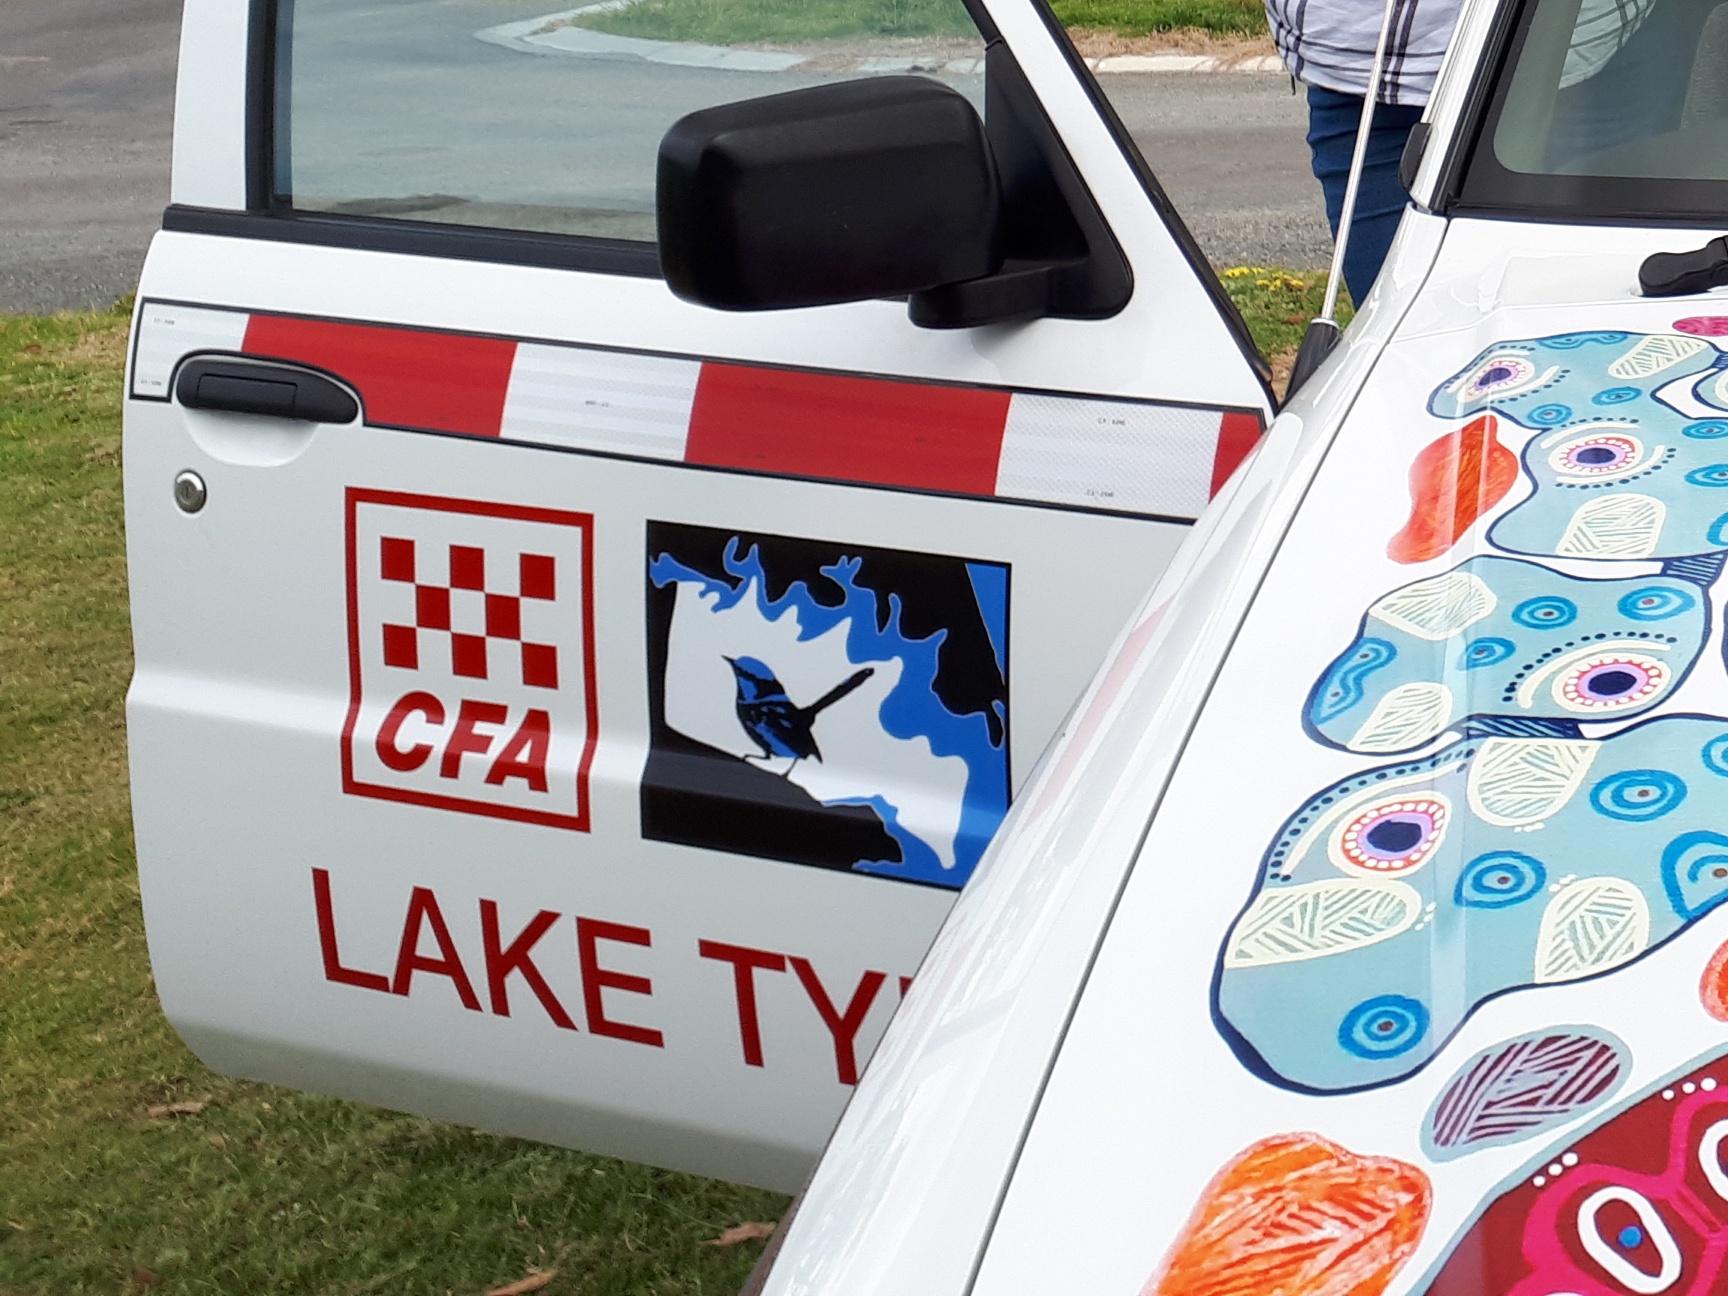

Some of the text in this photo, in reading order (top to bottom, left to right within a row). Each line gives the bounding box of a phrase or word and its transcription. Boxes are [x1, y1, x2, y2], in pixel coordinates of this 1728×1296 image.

[375, 691, 551, 793] CFA
[312, 867, 912, 1085] LAKE TY
